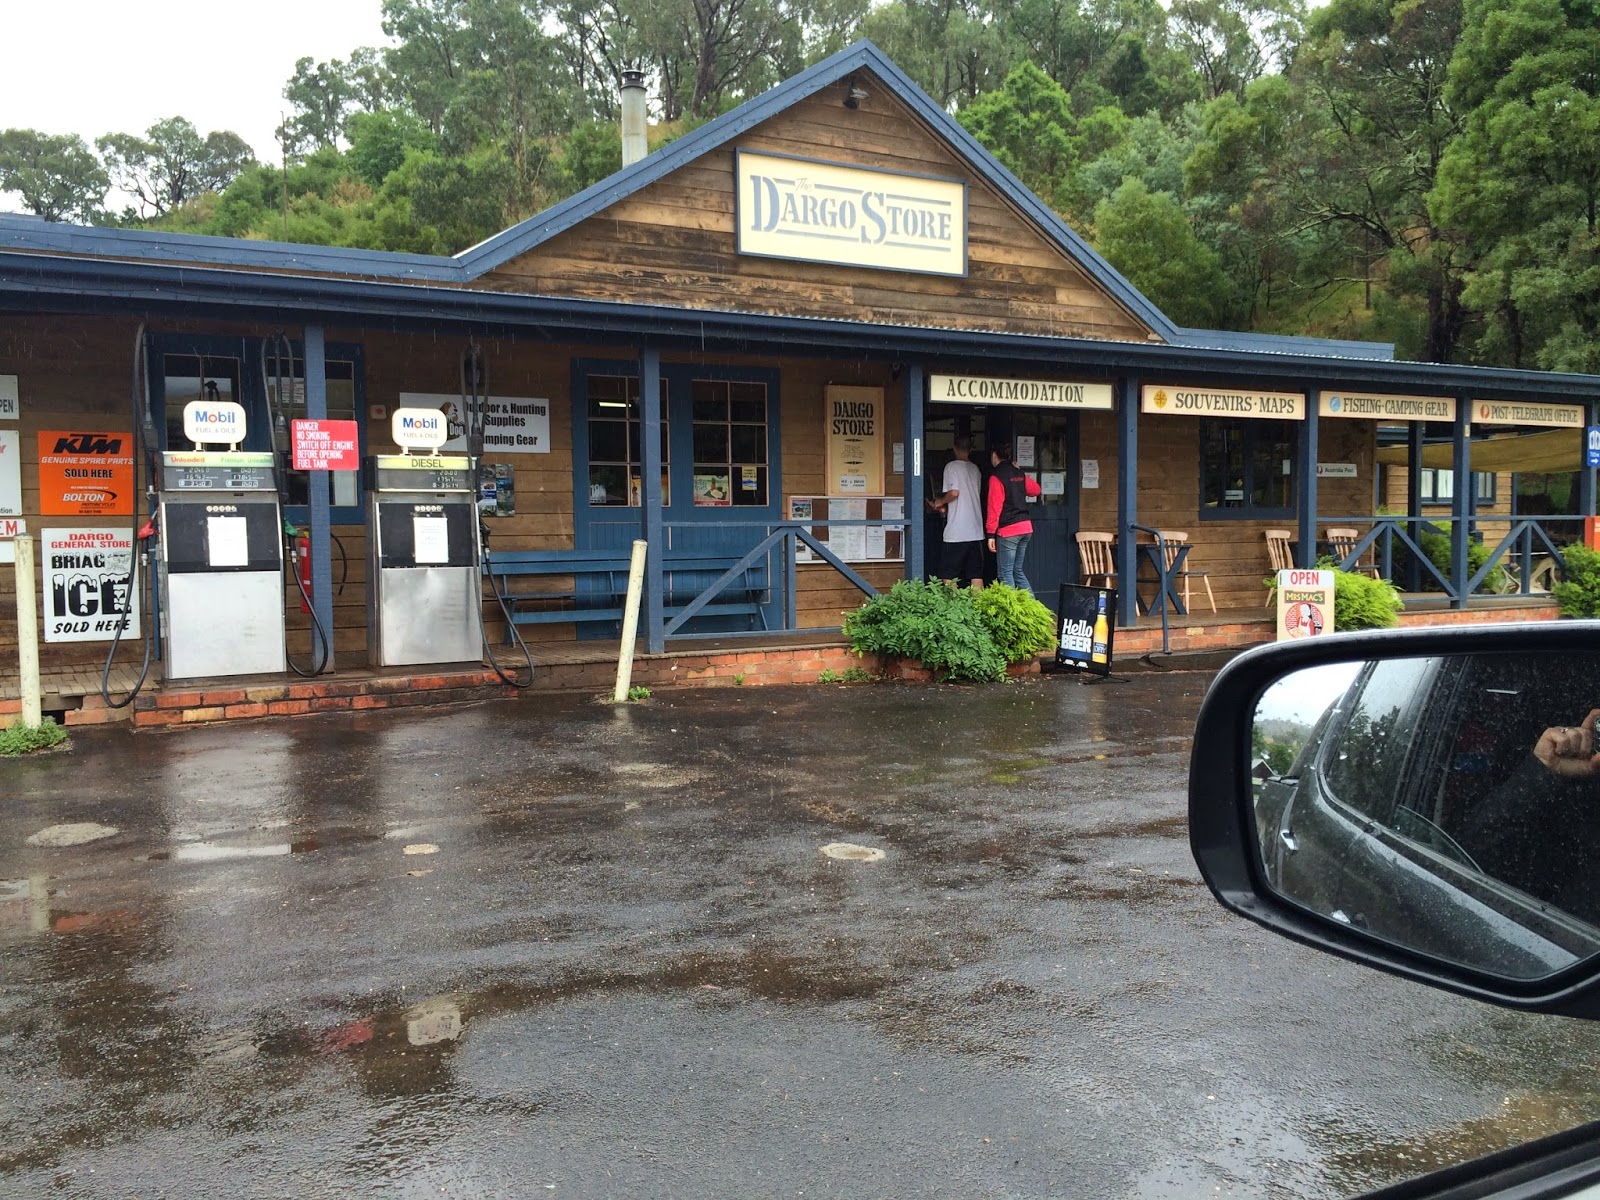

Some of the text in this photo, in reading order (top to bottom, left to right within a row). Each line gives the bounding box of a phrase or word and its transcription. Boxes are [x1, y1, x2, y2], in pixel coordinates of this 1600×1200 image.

[795, 177, 814, 191] The
[750, 175, 952, 244] DARGO STORE
[946, 379, 1084, 403] ACCOMMODATION
[502, 404, 509, 414] &
[510, 403, 546, 416] Hunting
[833, 401, 874, 418] DARGO
[1175, 392, 1295, 414] SOUVENIRS MAPS
[1425, 402, 1448, 417] GEAR
[195, 411, 236, 423] Mobil
[485, 414, 526, 427] Supplies
[1554, 408, 1578, 423] OFFICE
[296, 422, 319, 431] DANGER
[402, 417, 438, 429] Mobil
[449, 422, 464, 436] Dog
[832, 419, 874, 436] STORE
[296, 431, 330, 441] NO SMOKING
[483, 434, 538, 446] mping Gear
[53, 434, 121, 454] KTM
[297, 441, 354, 450] SWITCH OFF ENGINE
[297, 450, 343, 459] BEFORE OPENING
[298, 459, 328, 469] FUEL TANK
[411, 459, 444, 468] DIESEL
[64, 469, 113, 478] SOLD HERE
[62, 493, 106, 502] BOLTON
[69, 533, 114, 541] DARGO
[51, 541, 96, 549] GENERAL
[51, 552, 106, 569] BRIAG
[1290, 571, 1320, 586] OPEN
[52, 572, 132, 617] ICE
[53, 619, 131, 634] SOLD HERE
[1062, 618, 1093, 638] Hello
[1061, 634, 1092, 653] BEER
